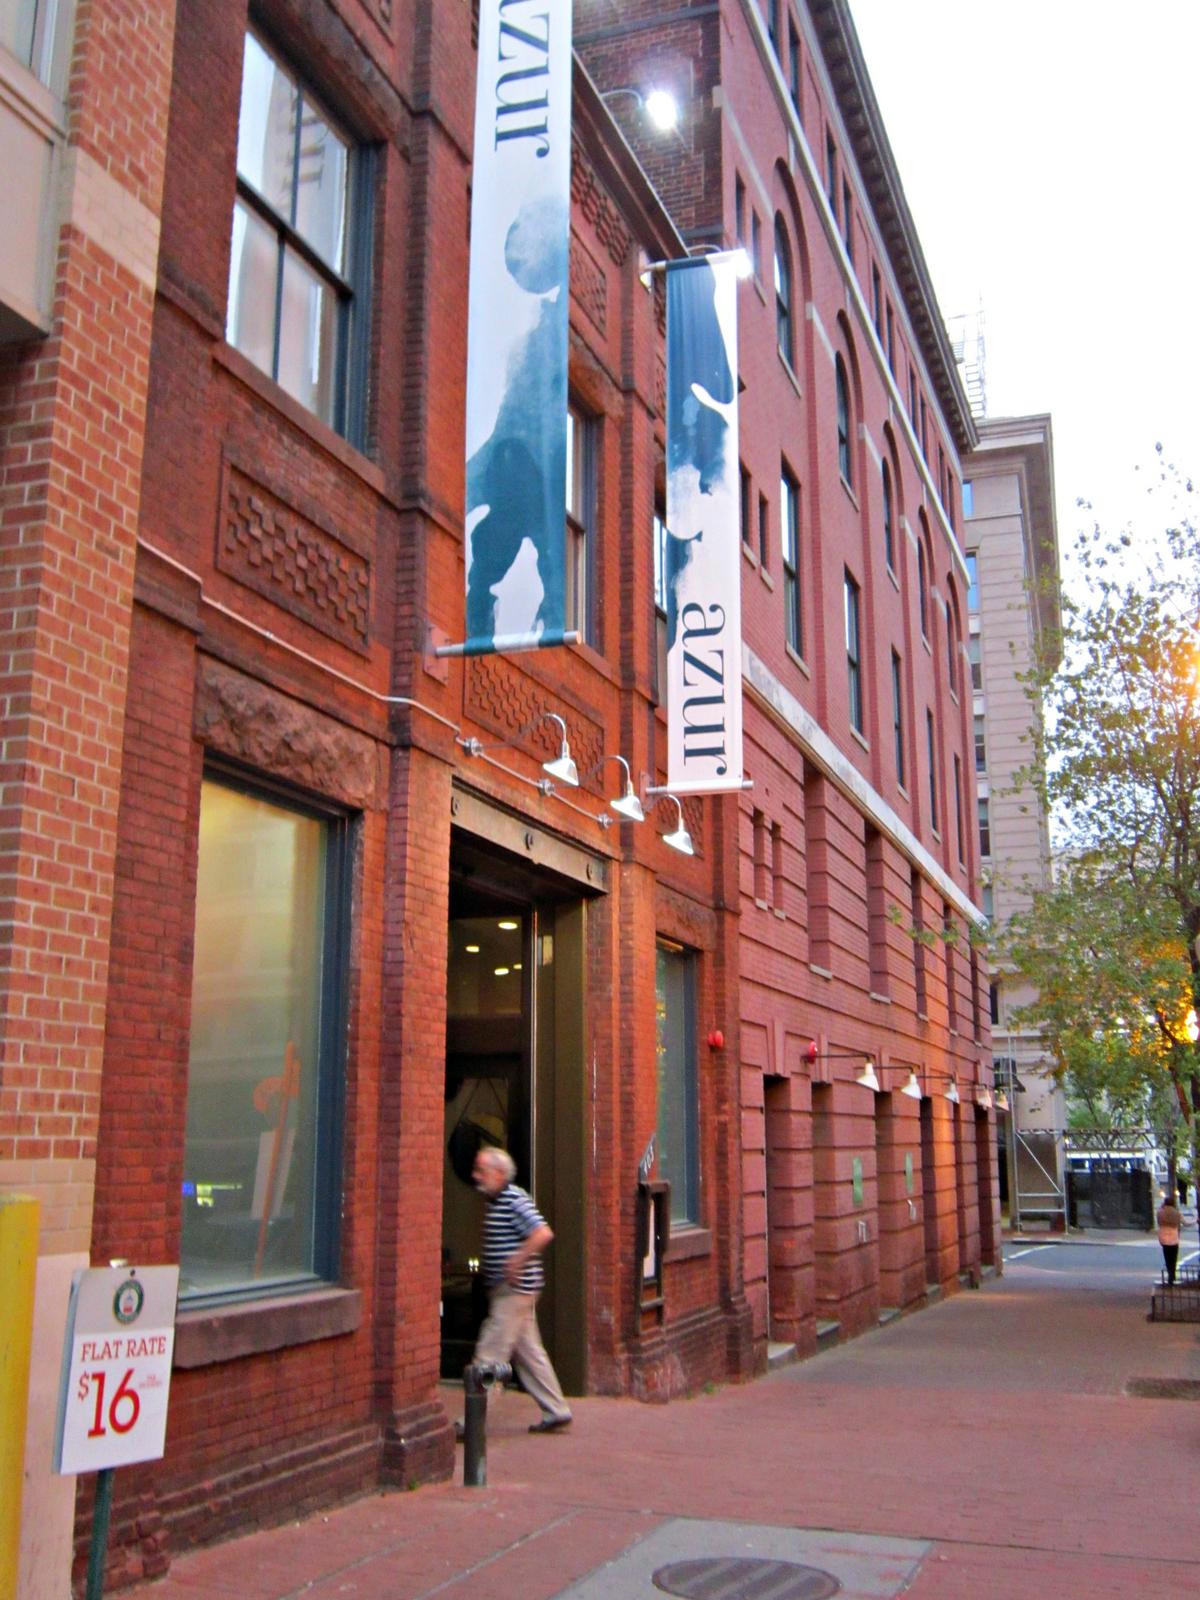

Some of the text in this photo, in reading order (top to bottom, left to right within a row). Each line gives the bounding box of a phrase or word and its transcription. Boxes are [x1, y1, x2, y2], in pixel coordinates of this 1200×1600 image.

[494, 0, 551, 159] zur
[681, 602, 728, 776] azur
[77, 1367, 141, 1439] $16
[80, 1335, 167, 1363] FLAT RATE
